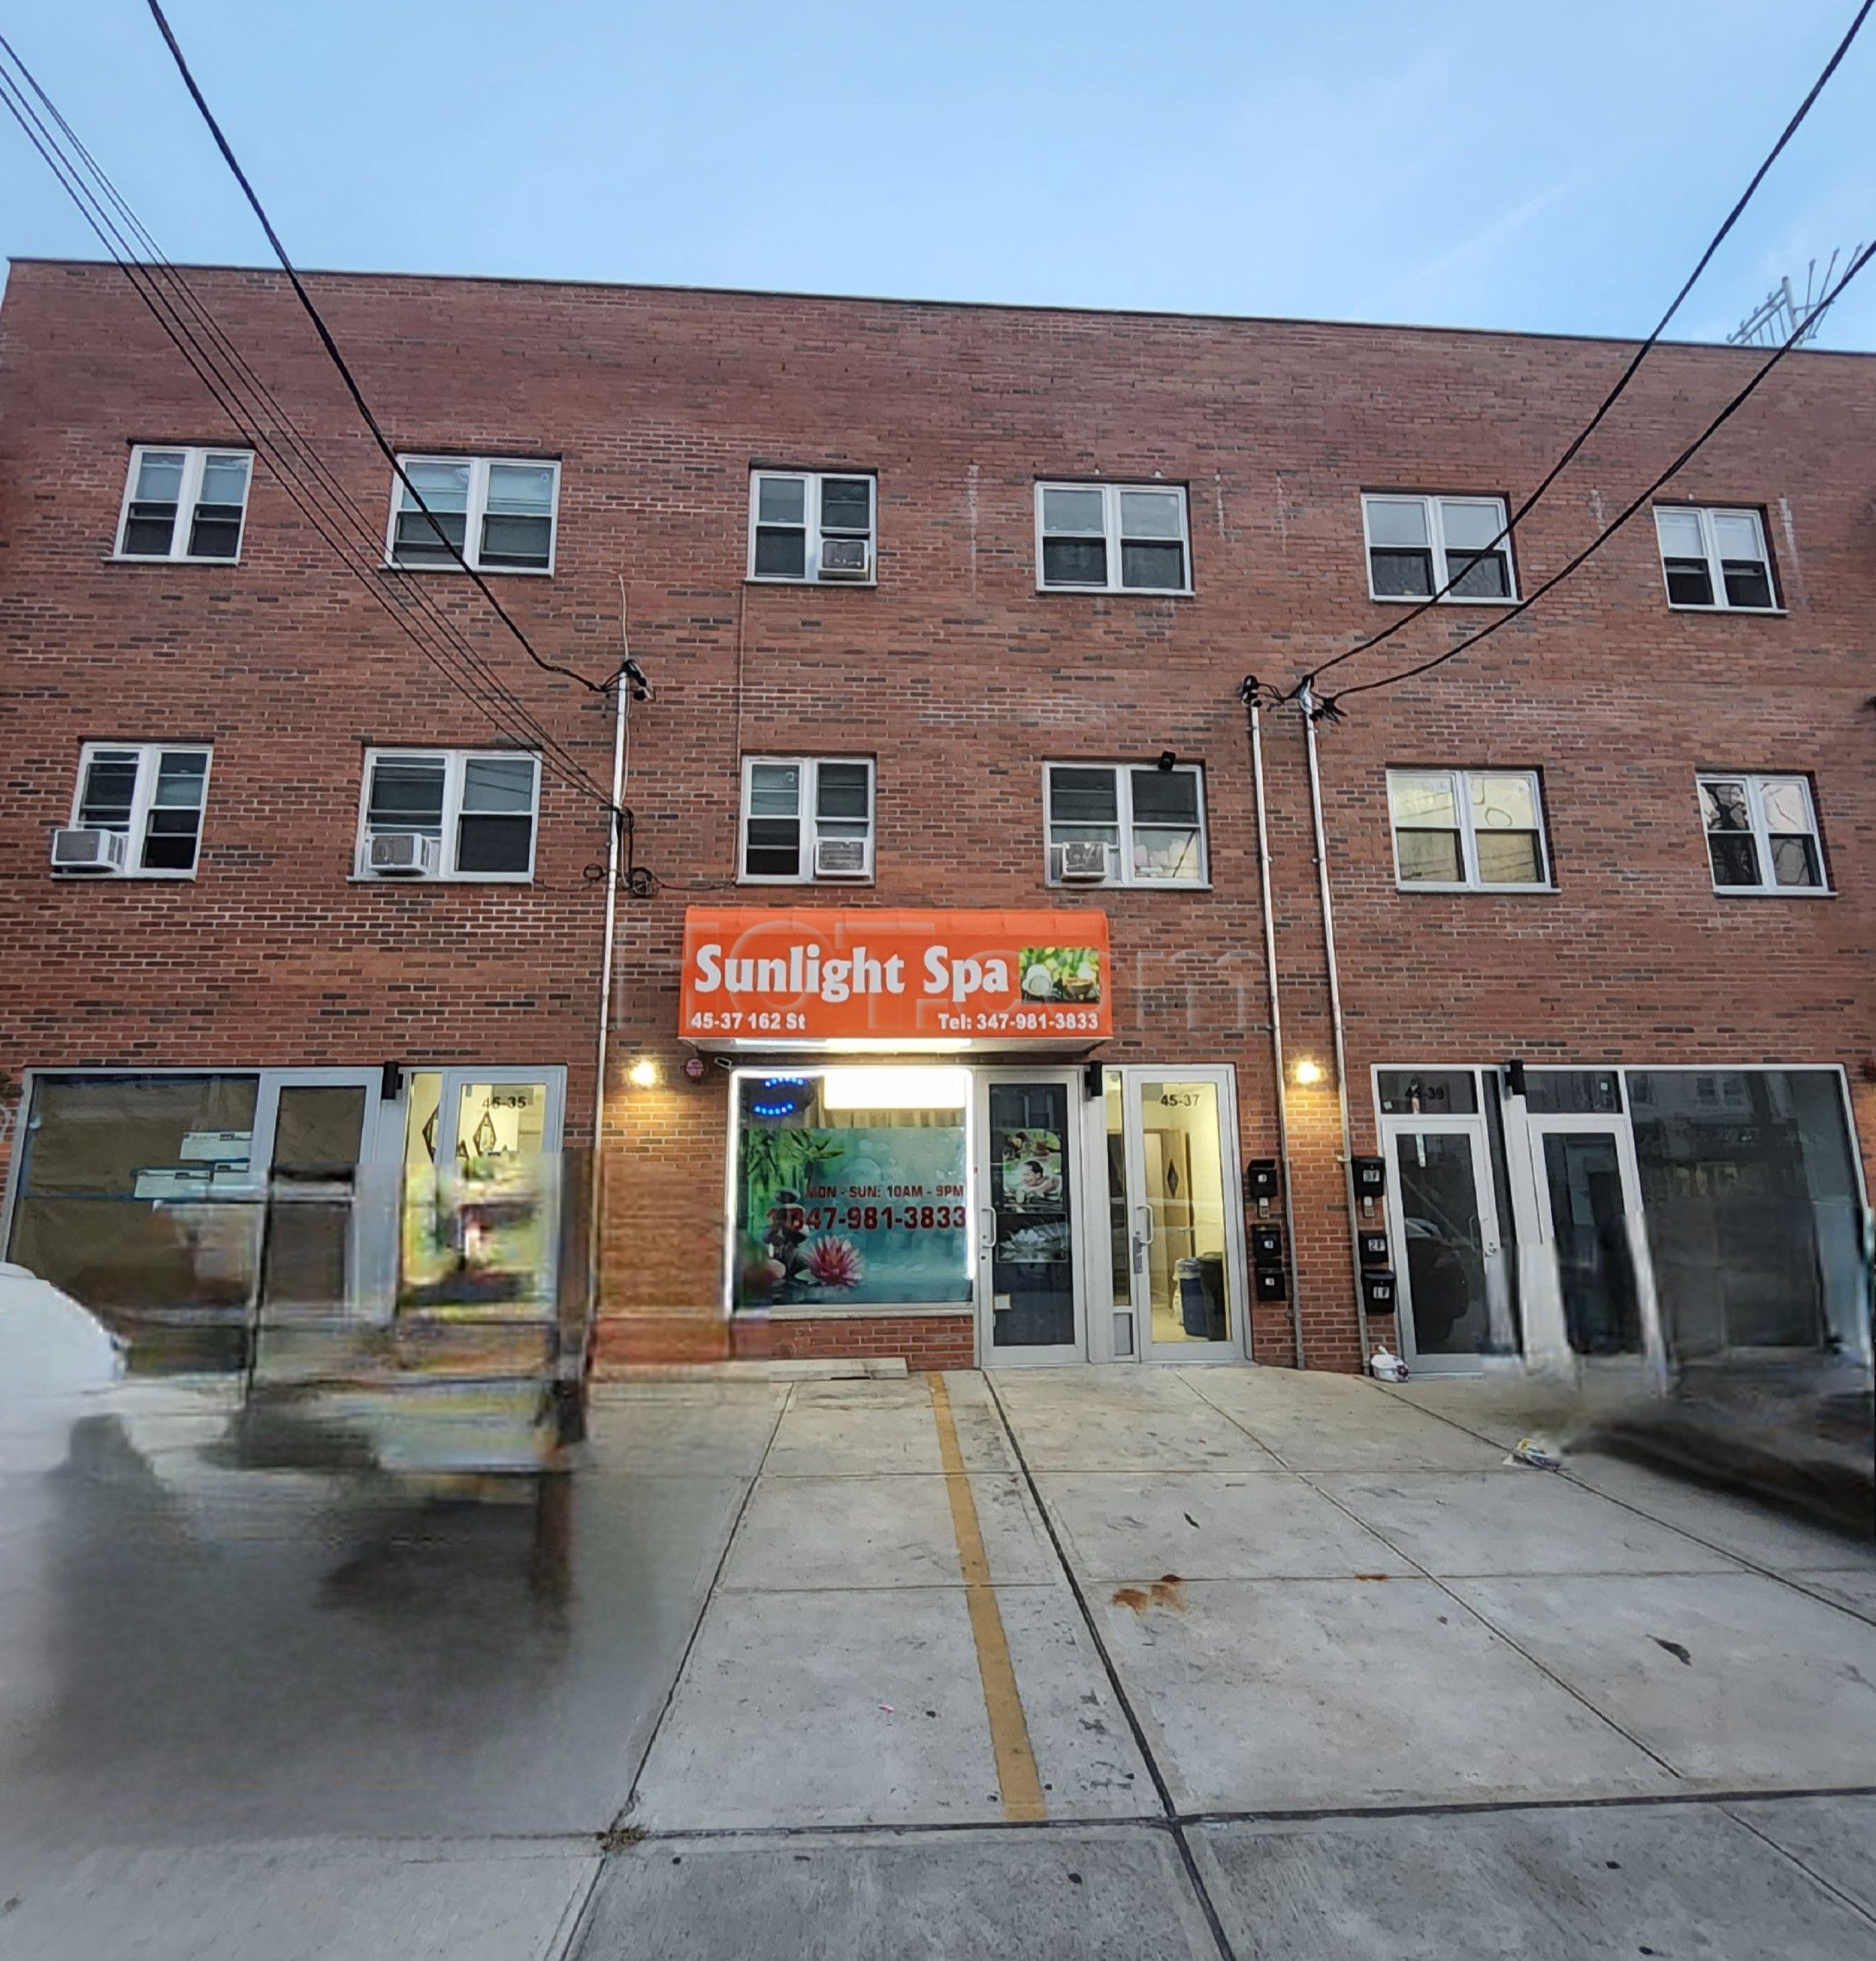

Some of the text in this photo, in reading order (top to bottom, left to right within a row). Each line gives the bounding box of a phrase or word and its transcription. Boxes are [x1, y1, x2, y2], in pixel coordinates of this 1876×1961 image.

[694, 943, 1009, 1003] Sunlight Spa
[691, 1012, 806, 1030] 45-37 162 St
[938, 1012, 1098, 1030] Tel: 347-981-3833
[482, 1096, 527, 1109] 45-35
[1160, 1093, 1199, 1106] 45-37
[806, 1186, 836, 1198] MON
[849, 1186, 881, 1198] SUN:
[887, 1185, 922, 1198] 10AM
[936, 1185, 963, 1198] 9PM
